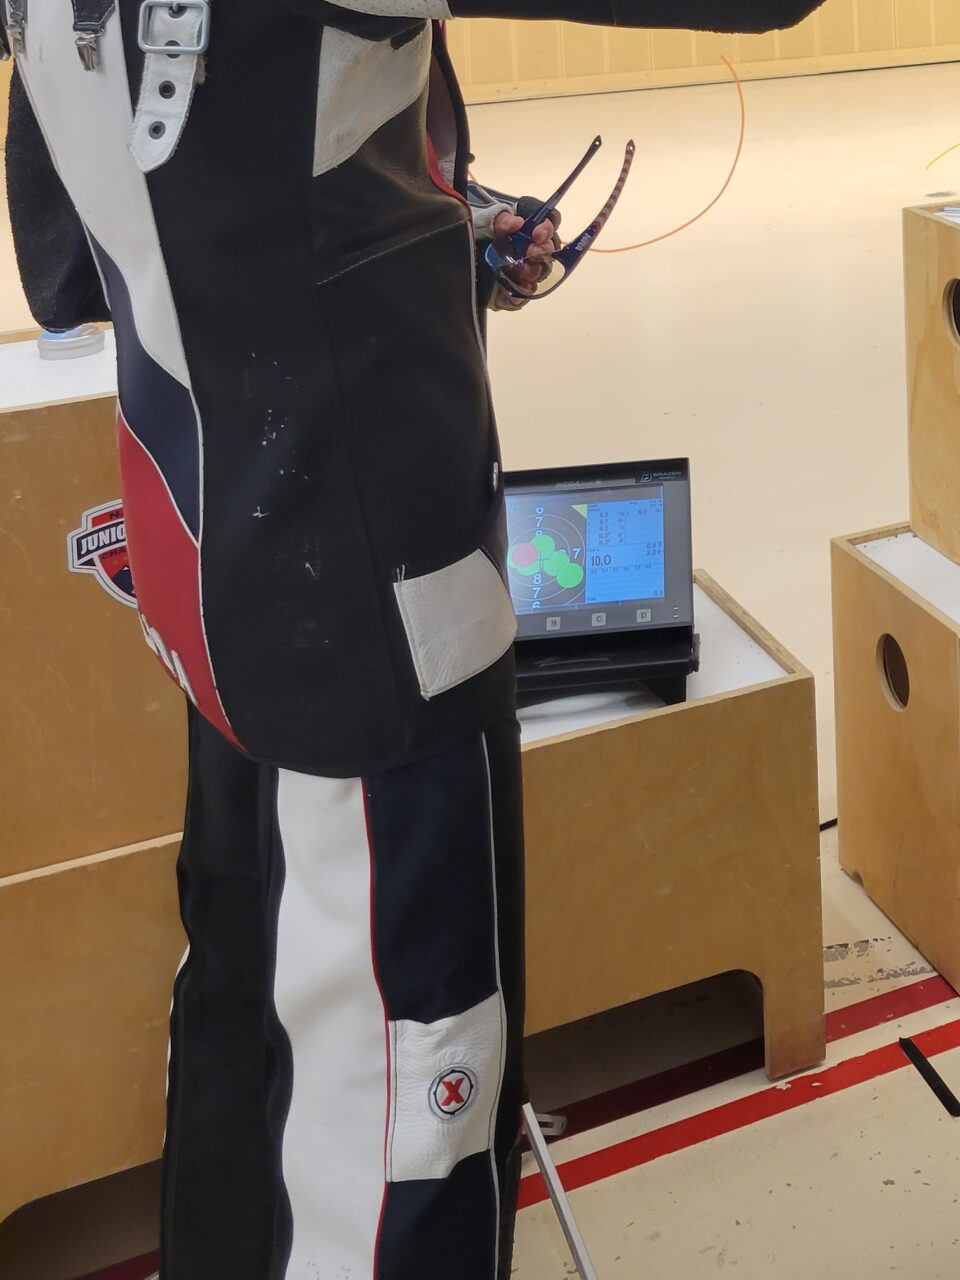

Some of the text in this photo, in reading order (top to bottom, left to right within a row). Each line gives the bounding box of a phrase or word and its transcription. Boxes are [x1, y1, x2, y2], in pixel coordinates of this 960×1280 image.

[536, 516, 543, 527] 7
[572, 548, 580, 559] 7
[591, 554, 612, 567] 10.0
[533, 574, 542, 585] 8
[532, 588, 540, 598] 7
